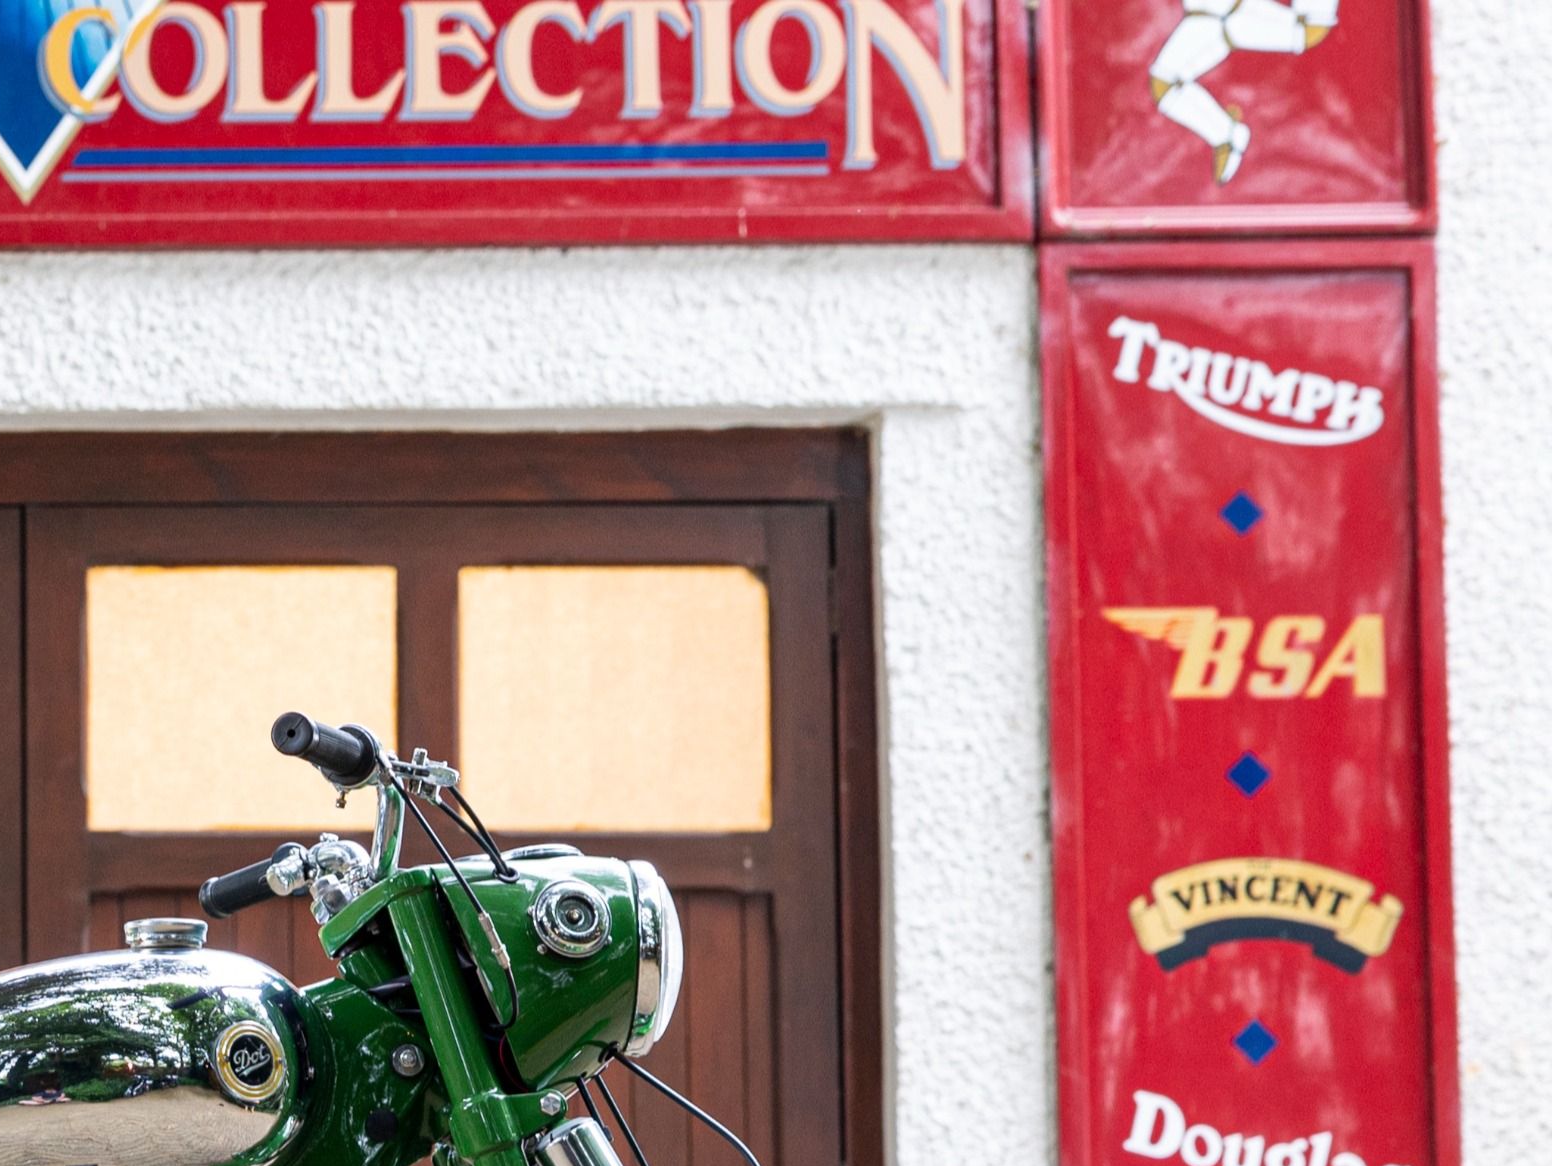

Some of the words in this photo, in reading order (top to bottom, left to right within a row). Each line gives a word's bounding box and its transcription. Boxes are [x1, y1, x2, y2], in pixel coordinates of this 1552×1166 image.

[38, 0, 967, 170] COLLECTION
[1108, 316, 1384, 447] TRIUMPH
[1102, 606, 1388, 698] BSA
[1170, 874, 1353, 919] VINCENT
[233, 1043, 271, 1077] Dot
